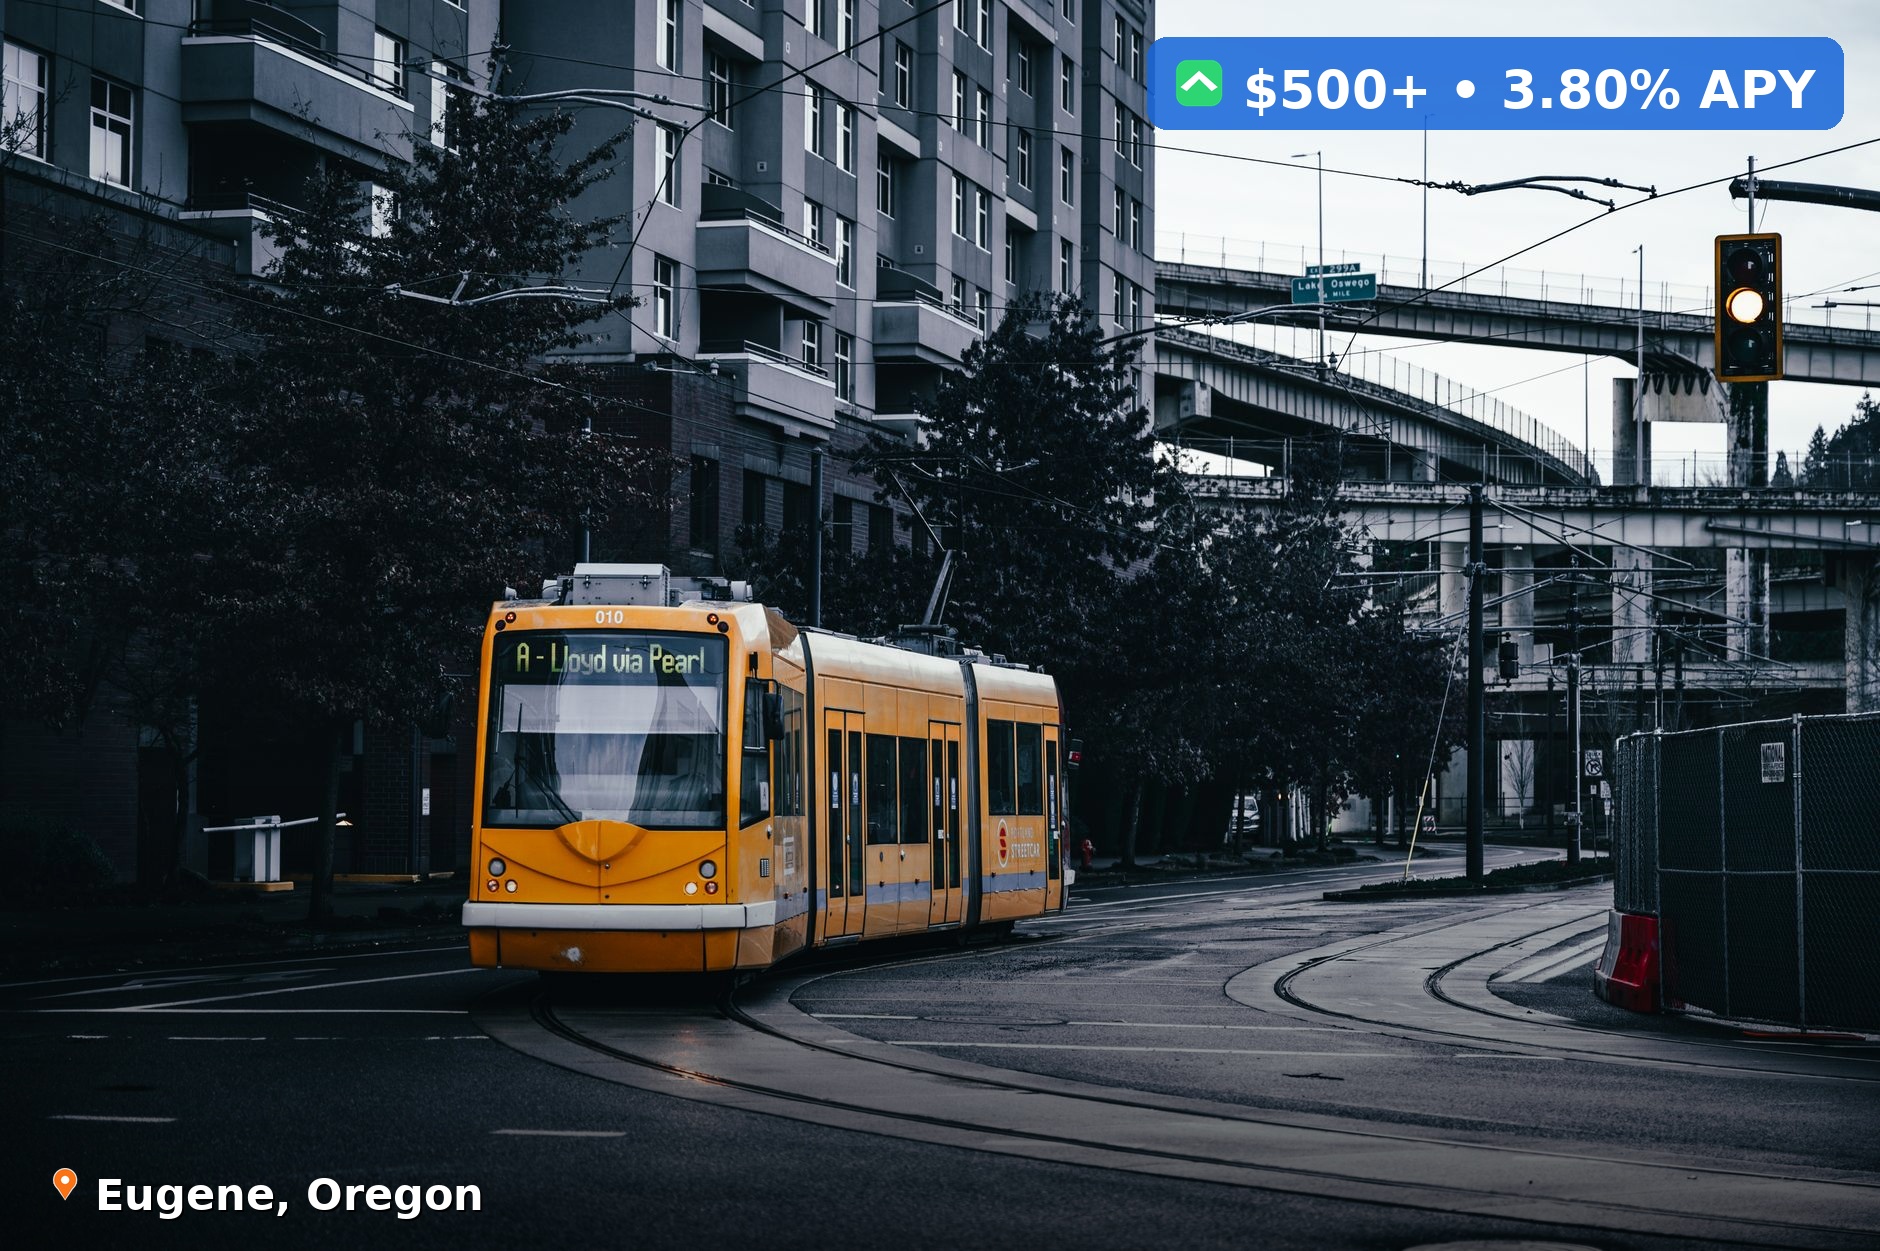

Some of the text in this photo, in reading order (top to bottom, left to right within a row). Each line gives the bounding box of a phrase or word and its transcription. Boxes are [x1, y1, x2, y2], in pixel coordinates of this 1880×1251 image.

[1329, 264, 1356, 273] 299A
[1331, 279, 1370, 289] Oswego
[595, 610, 624, 624] 010
[517, 643, 530, 673] A
[551, 643, 606, 675] Lloyd
[613, 647, 643, 674] via
[650, 644, 705, 674] Pearl
[1012, 843, 1040, 858] STREETCAR
